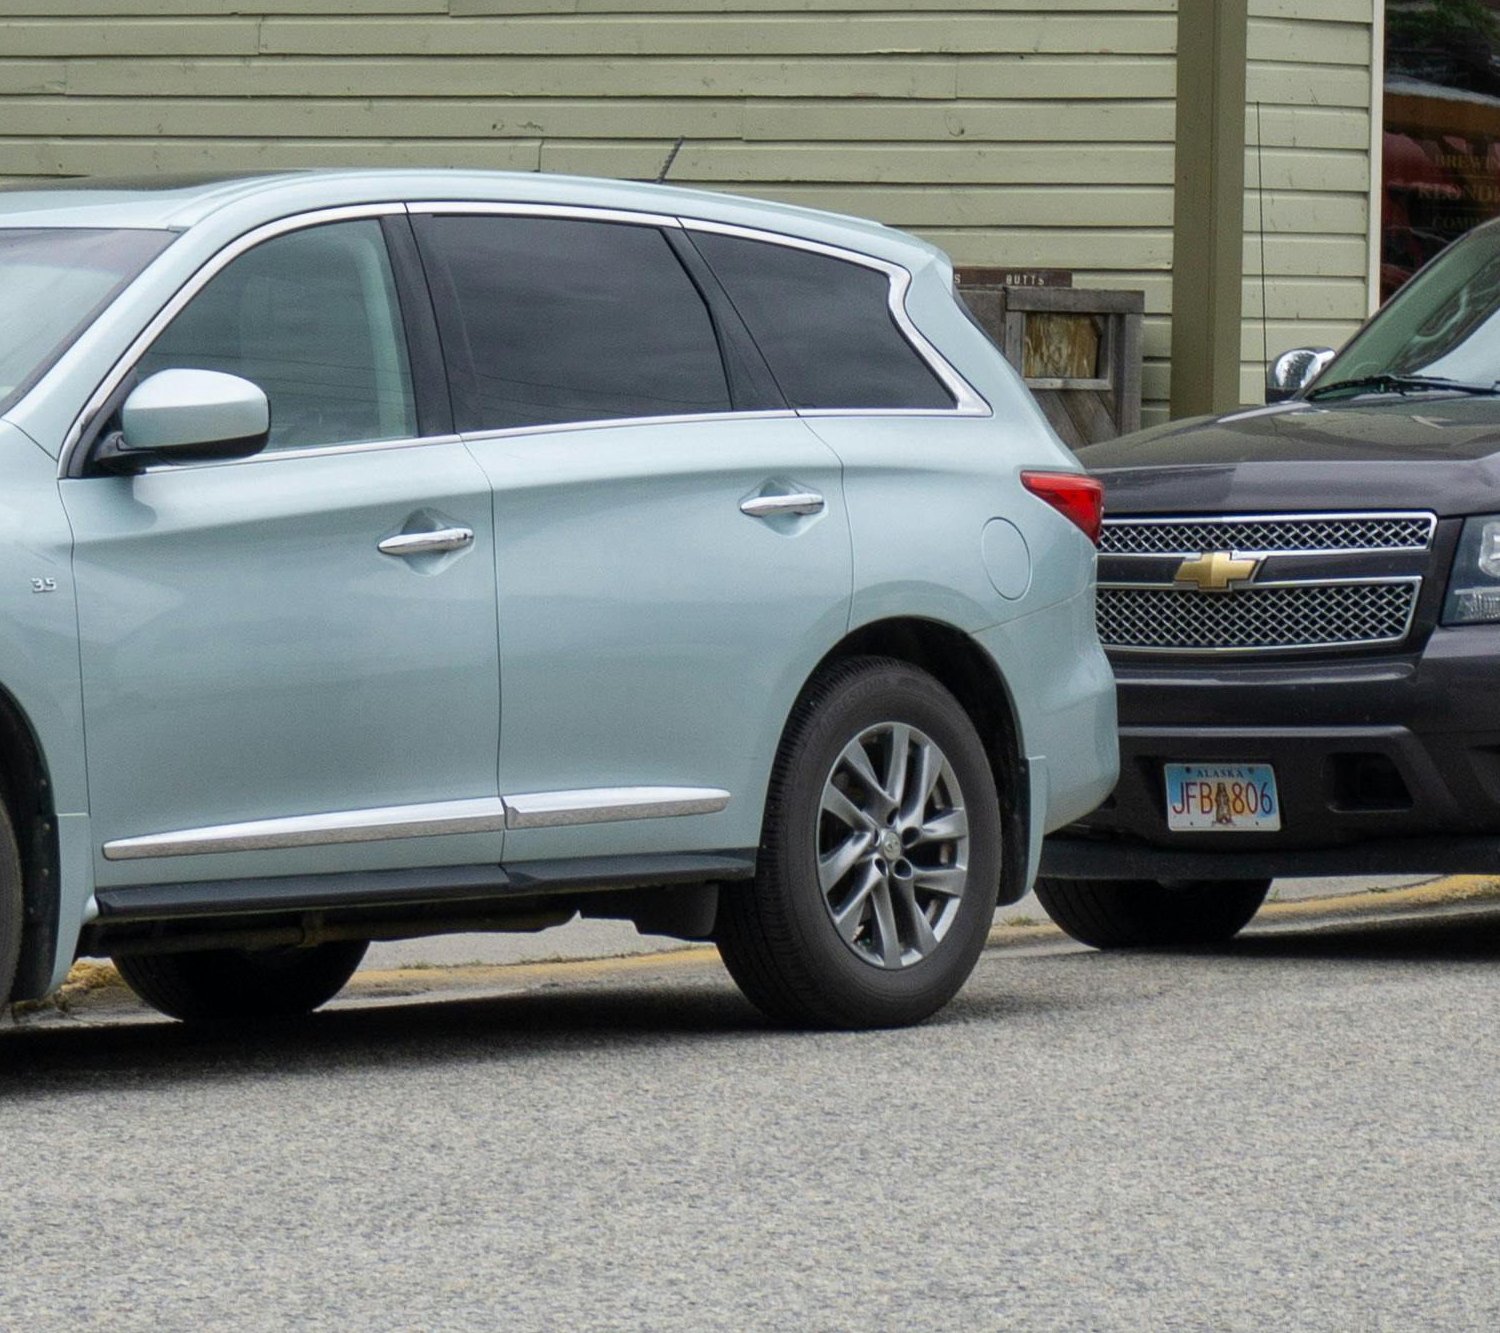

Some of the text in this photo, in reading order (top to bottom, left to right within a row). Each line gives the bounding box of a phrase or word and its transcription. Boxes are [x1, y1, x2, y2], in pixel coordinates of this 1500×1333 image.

[1005, 274, 1045, 286] BUTTS
[1196, 769, 1244, 779] ALASKA
[1172, 781, 1273, 815] JFB 806
